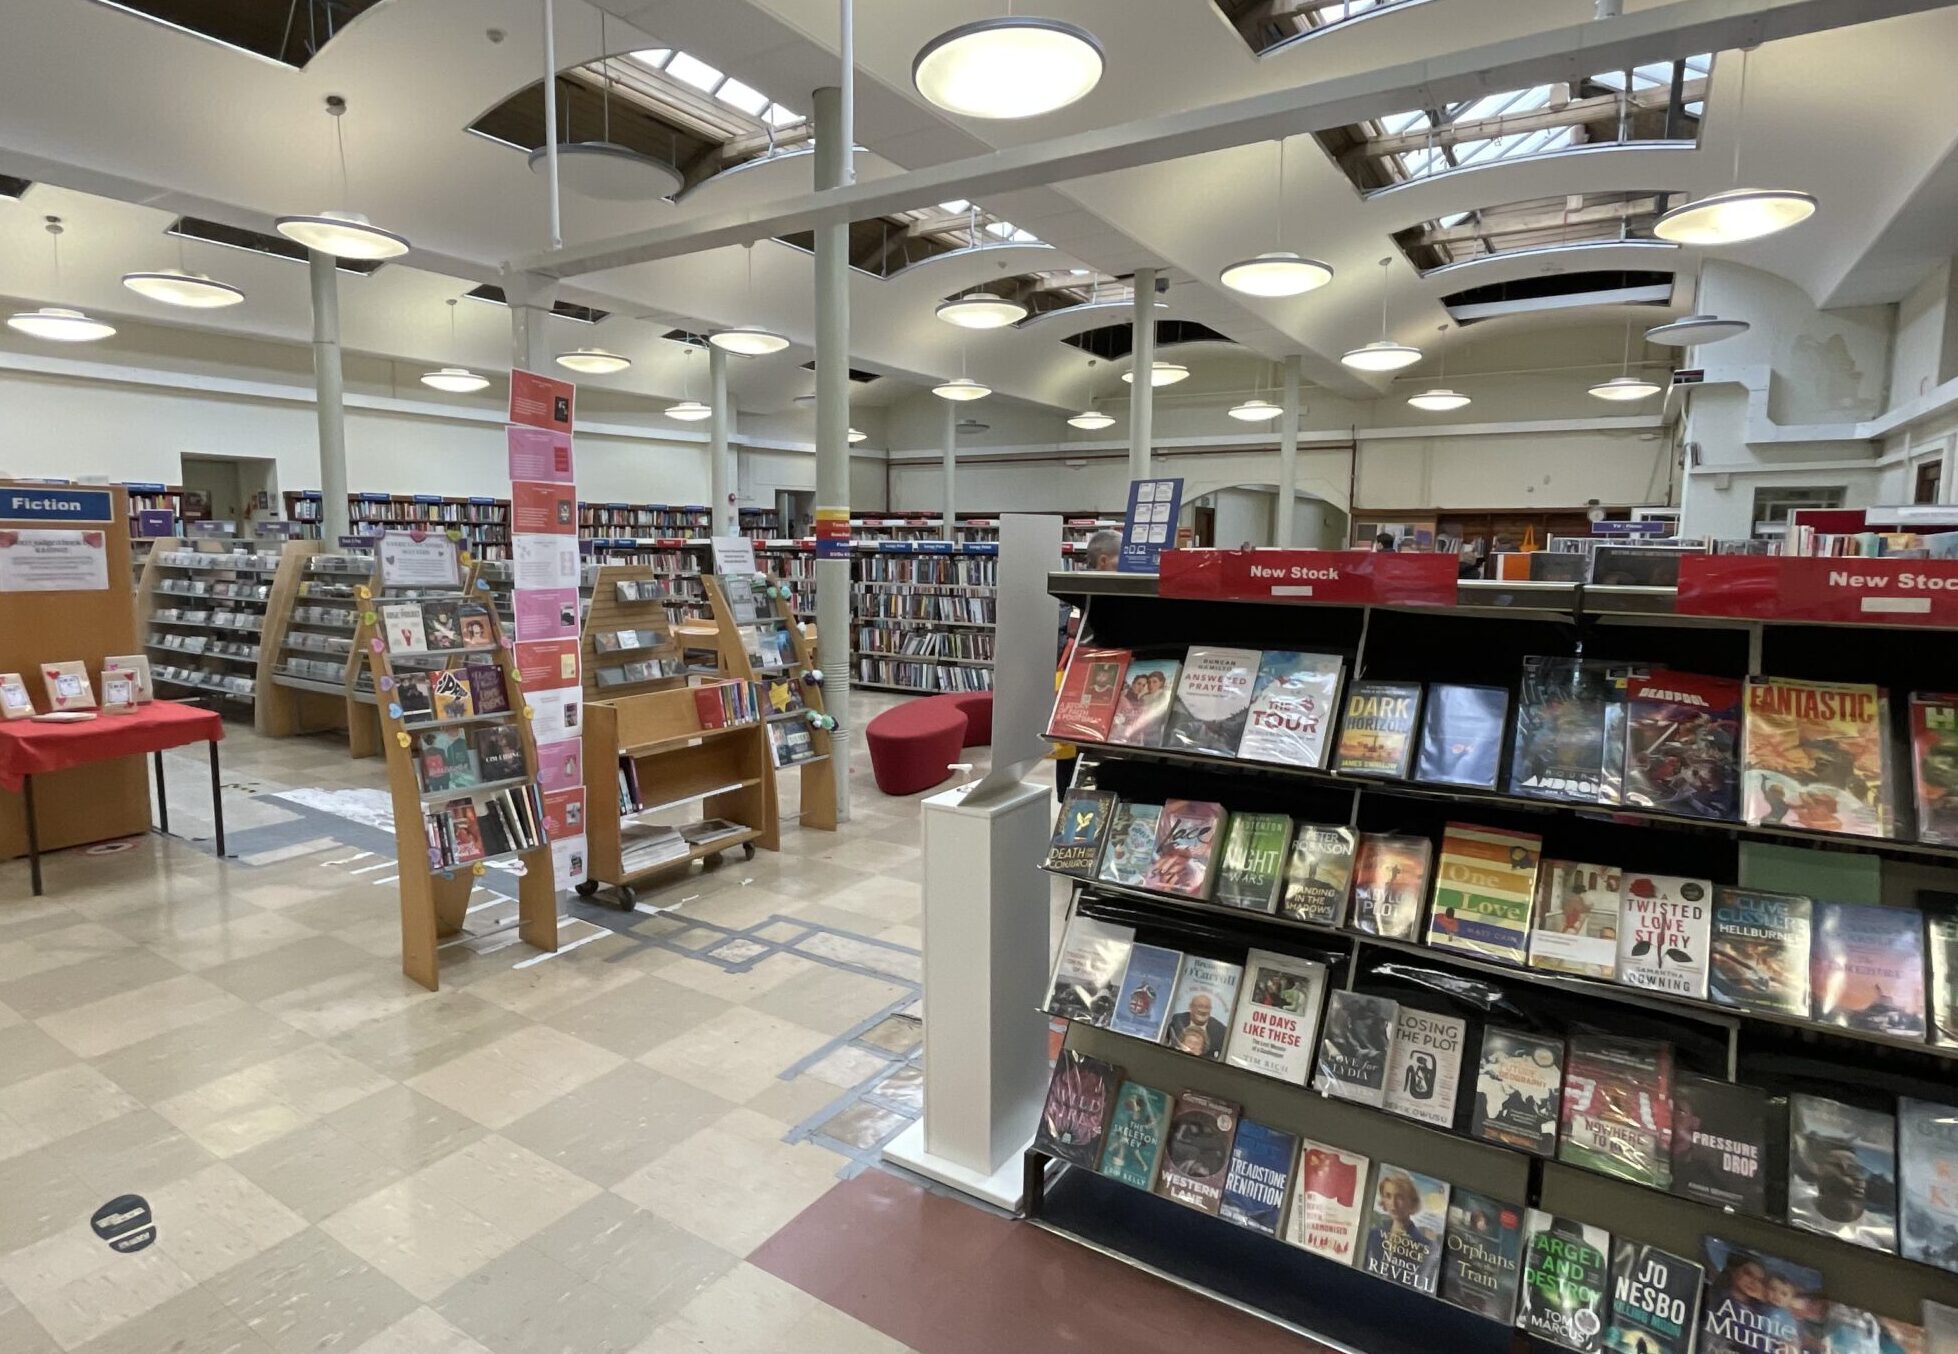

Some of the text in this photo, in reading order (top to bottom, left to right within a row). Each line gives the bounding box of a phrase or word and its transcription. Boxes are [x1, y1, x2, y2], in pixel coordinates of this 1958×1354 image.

[12, 497, 82, 511] Fiction
[1250, 565, 1339, 581] New Stock
[1829, 571, 1958, 590] New Stoc
[1189, 682, 1229, 693] PRAYE
[1638, 688, 1710, 708] DEADPOOL
[1268, 700, 1292, 712] THE
[1349, 695, 1412, 719] DARK
[1749, 686, 1875, 724] FANTASTIC
[1253, 710, 1319, 734] TOUR
[1051, 847, 1086, 859] DEATH
[1292, 840, 1353, 856] ROBINSON
[1450, 864, 1500, 888] One
[1293, 884, 1336, 898] ANDING
[1308, 896, 1326, 905] THE
[1462, 892, 1521, 920] Love
[1626, 898, 1703, 921] TWISTED
[1641, 915, 1686, 934] LOVE
[1628, 973, 1691, 992] DOWNING
[1252, 1011, 1297, 1032] ON DAYS
[1398, 1014, 1458, 1039] LOSING
[1242, 1022, 1302, 1048] LIKE THESE
[1395, 1028, 1459, 1053] THE PLOT
[1361, 1061, 1378, 1071] for
[1114, 1123, 1158, 1145] SKELETON
[1130, 1120, 1146, 1132] THE
[1585, 1118, 1645, 1146] NOWHERE
[1593, 1132, 1607, 1147] TO
[1692, 1131, 1759, 1159] PRESSURE
[1231, 1157, 1288, 1189] TREADSTONE
[1722, 1152, 1759, 1178] DROP
[1161, 1170, 1220, 1199] WESTERN
[1225, 1172, 1285, 1209] RENDITION
[1381, 1240, 1425, 1263] CHOICE
[1382, 1250, 1420, 1275] Nancy
[1447, 1235, 1516, 1271] Orphans
[1368, 1257, 1438, 1293] REVELL
[1457, 1260, 1498, 1290] Train
[1542, 1255, 1585, 1281] AND
[1638, 1260, 1668, 1290] JO
[1525, 1267, 1602, 1302] DESTROY
[1614, 1275, 1686, 1325] NESBO
[1531, 1314, 1586, 1344] MARCUS
[1544, 1308, 1574, 1327] TOM
[1715, 1299, 1798, 1340] Annie
[1704, 1310, 1809, 1354] Murra
